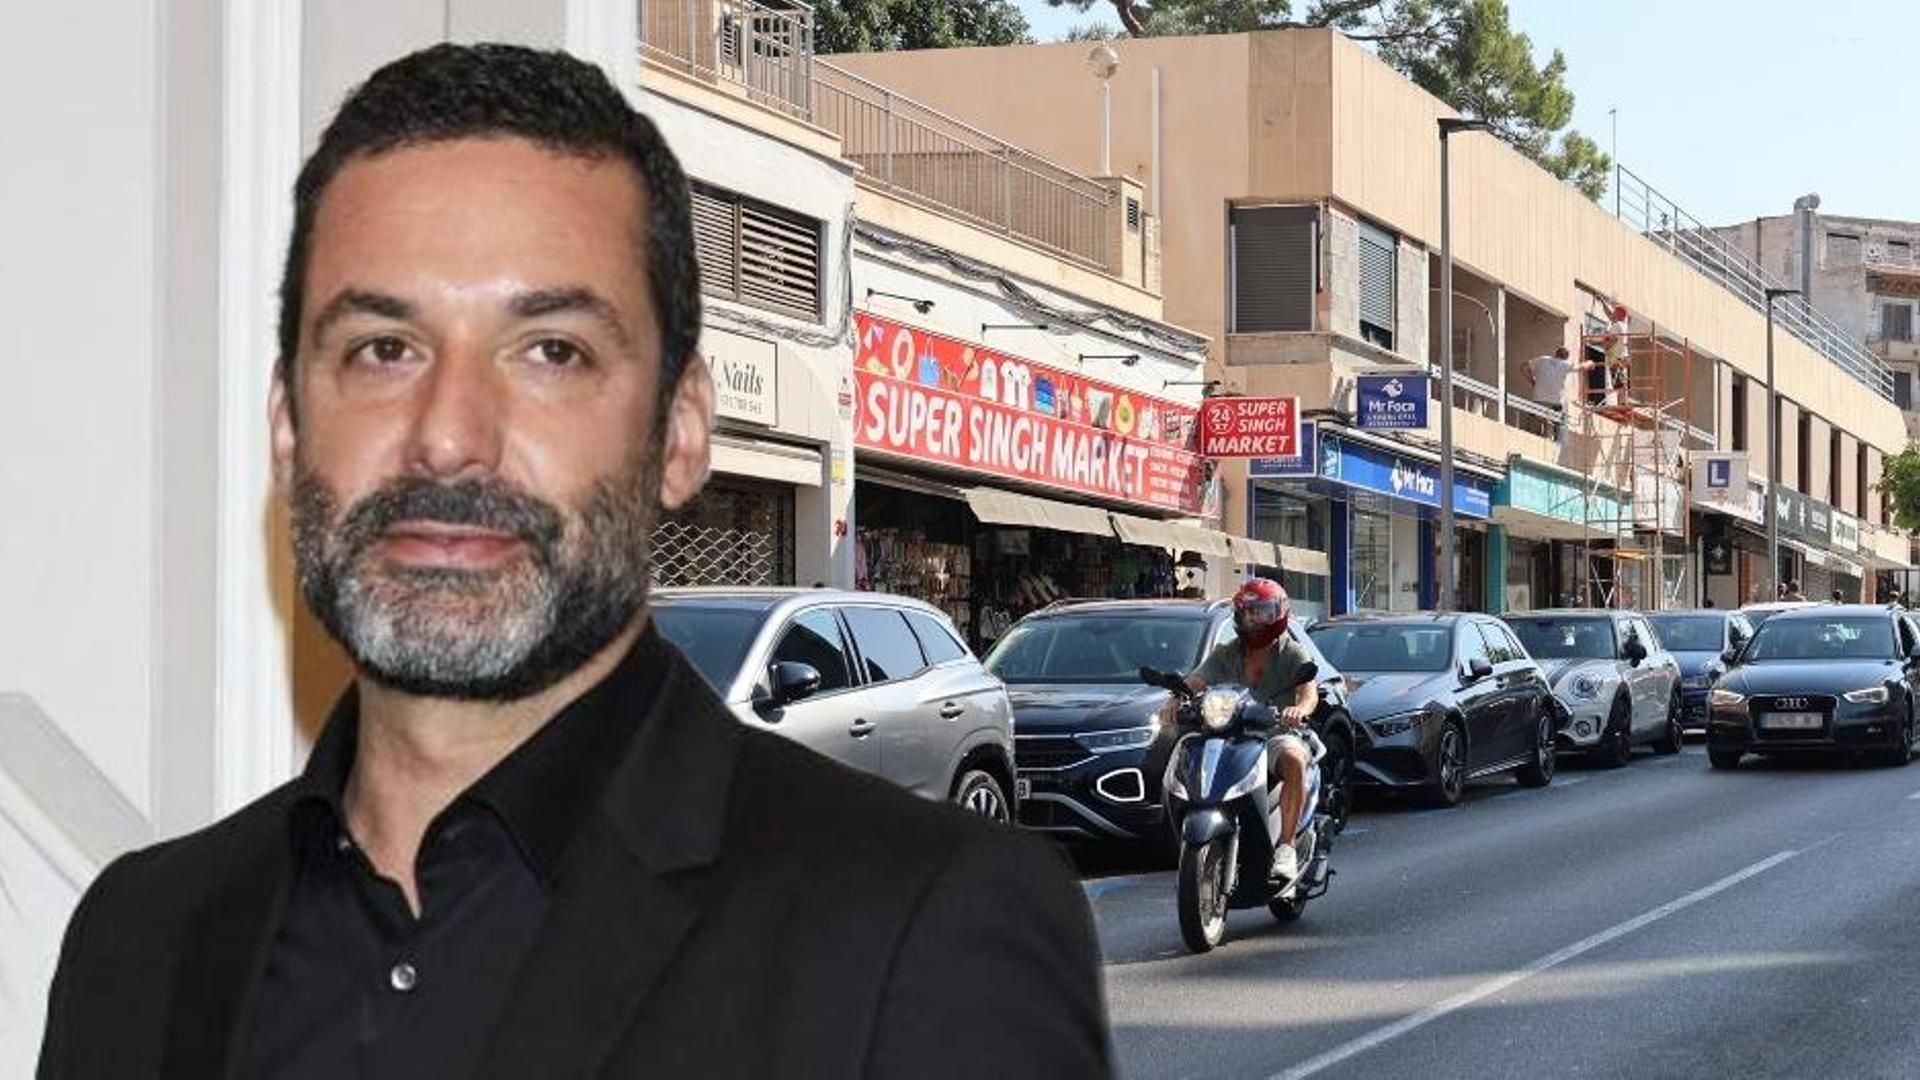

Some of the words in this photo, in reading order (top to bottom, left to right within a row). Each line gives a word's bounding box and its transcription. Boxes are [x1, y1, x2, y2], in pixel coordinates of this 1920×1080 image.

[718, 359, 764, 395] Nails
[1211, 407, 1231, 423] 24
[1236, 400, 1288, 416] SUPER
[1368, 400, 1385, 412] Mr
[1387, 400, 1416, 412] Foca
[1237, 417, 1287, 433] SINGH
[865, 381, 963, 458] SUPER
[969, 404, 1049, 476] SINGH
[1052, 426, 1149, 495] MARKET
[1207, 435, 1290, 454] MARKET
[1416, 469, 1434, 496] Foca
[1711, 461, 1727, 485] L
